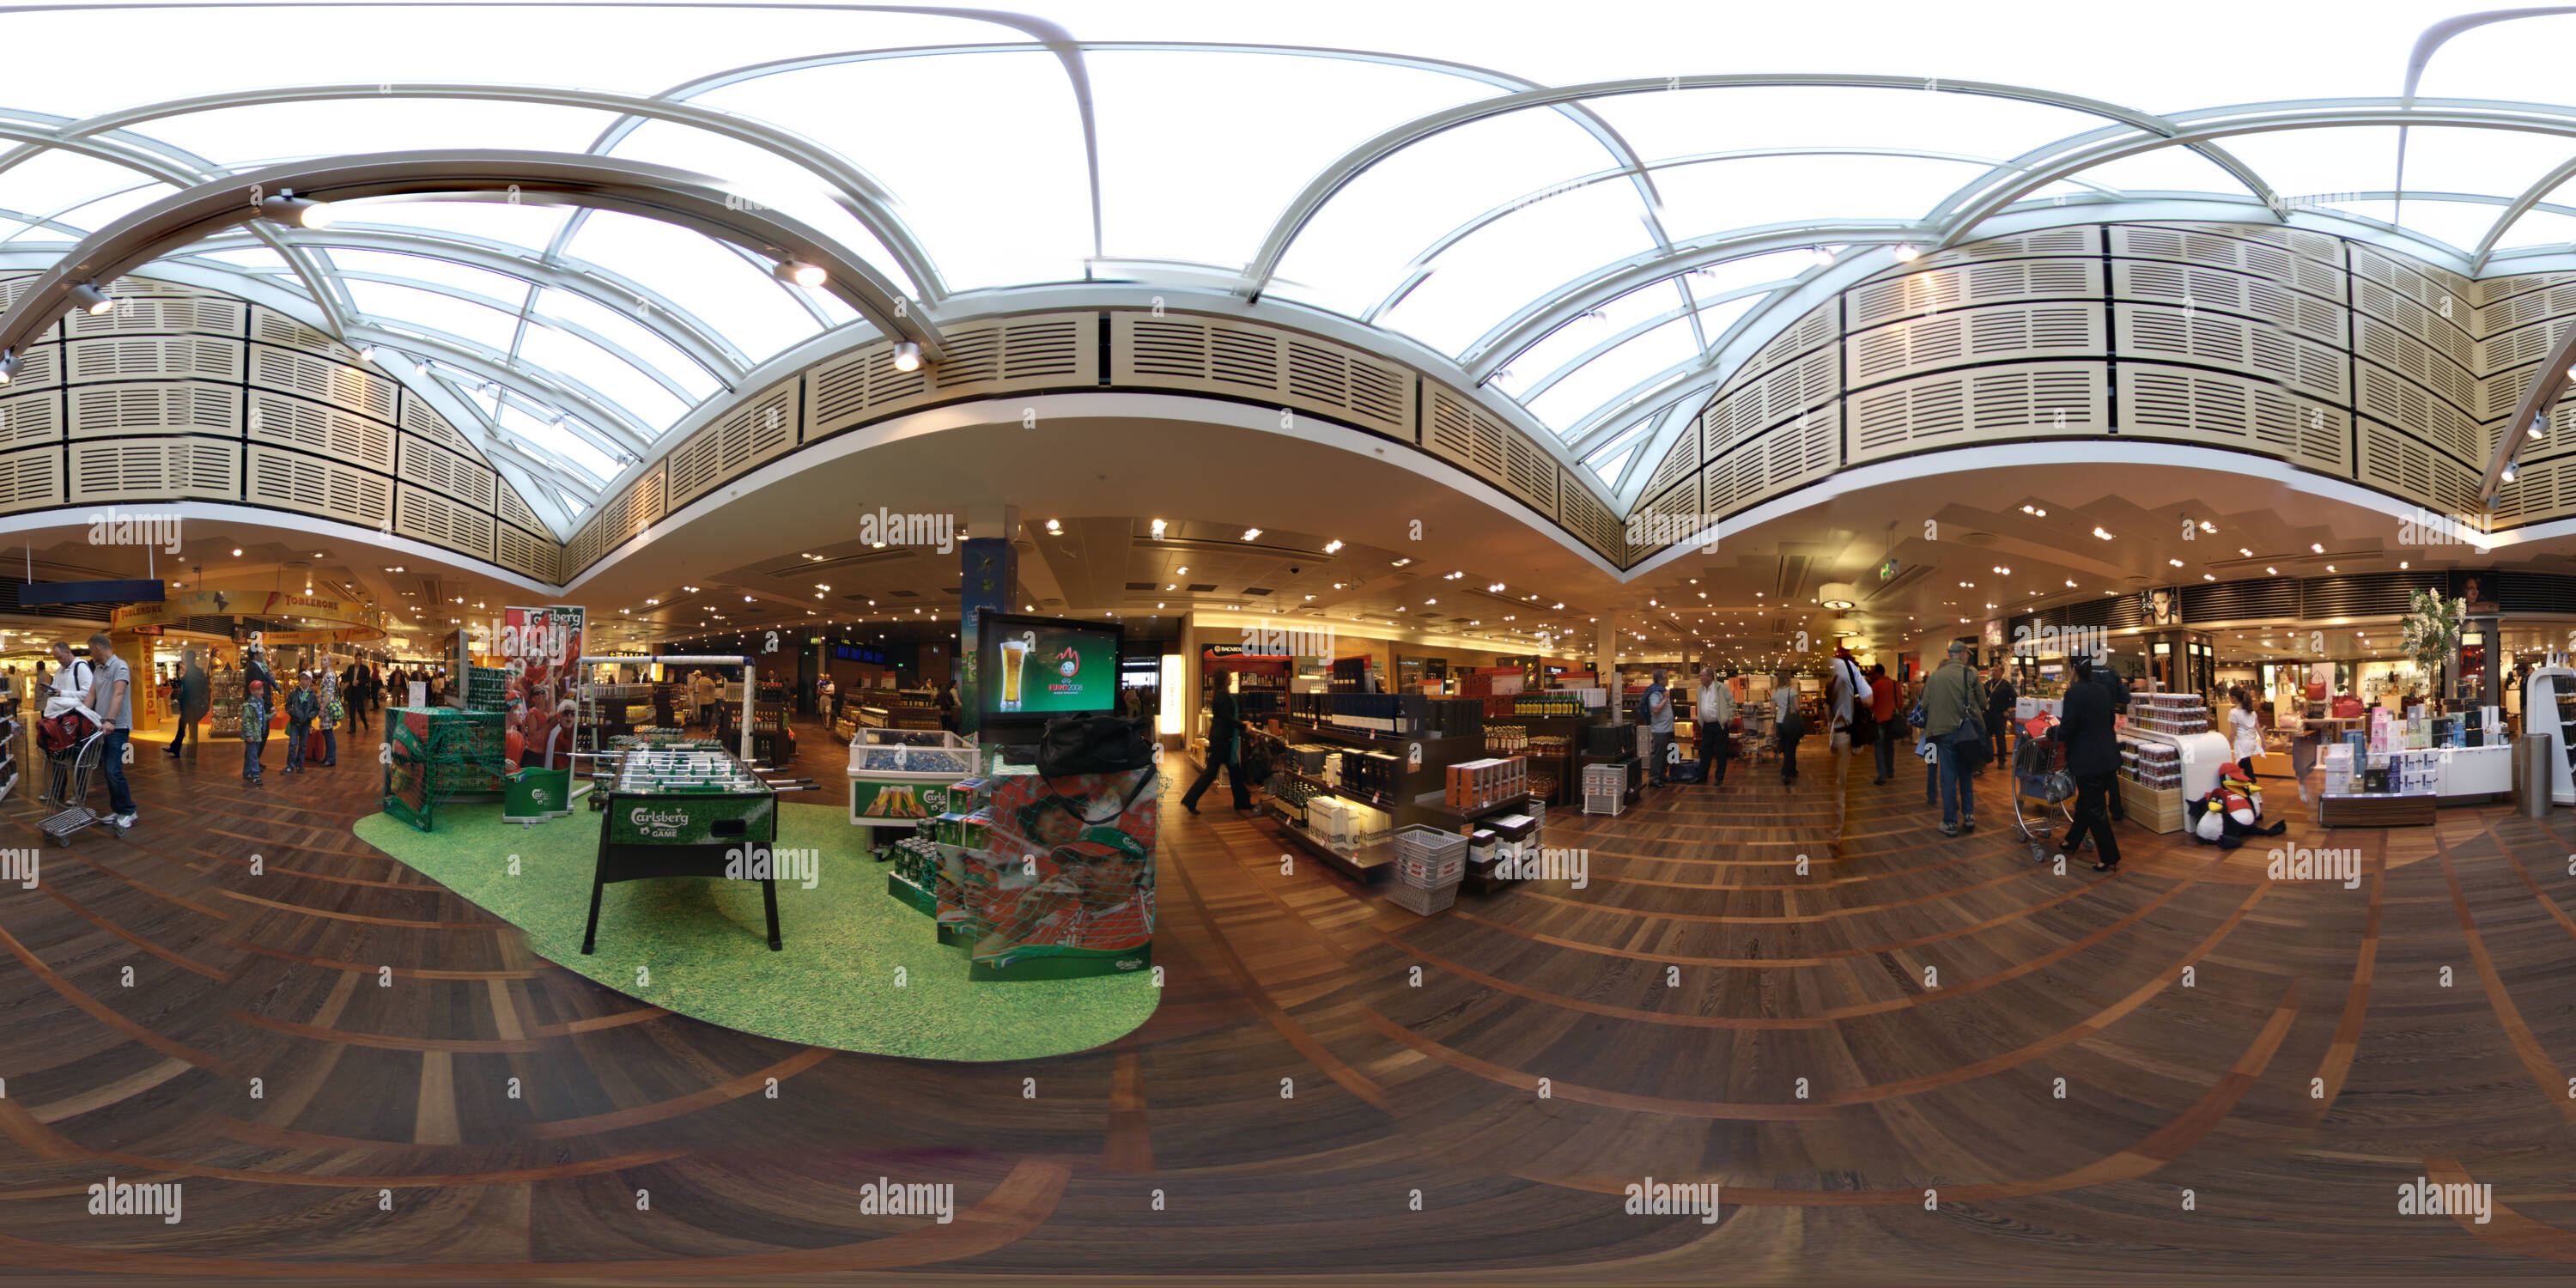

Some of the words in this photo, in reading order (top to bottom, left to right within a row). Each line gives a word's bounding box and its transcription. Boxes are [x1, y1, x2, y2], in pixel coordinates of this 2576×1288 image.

[285, 594, 338, 611] TOBLERONE
[120, 605, 163, 620] TOBLERONE
[143, 637, 156, 716] TOBLERONE
[630, 807, 689, 826] Carlsberg
